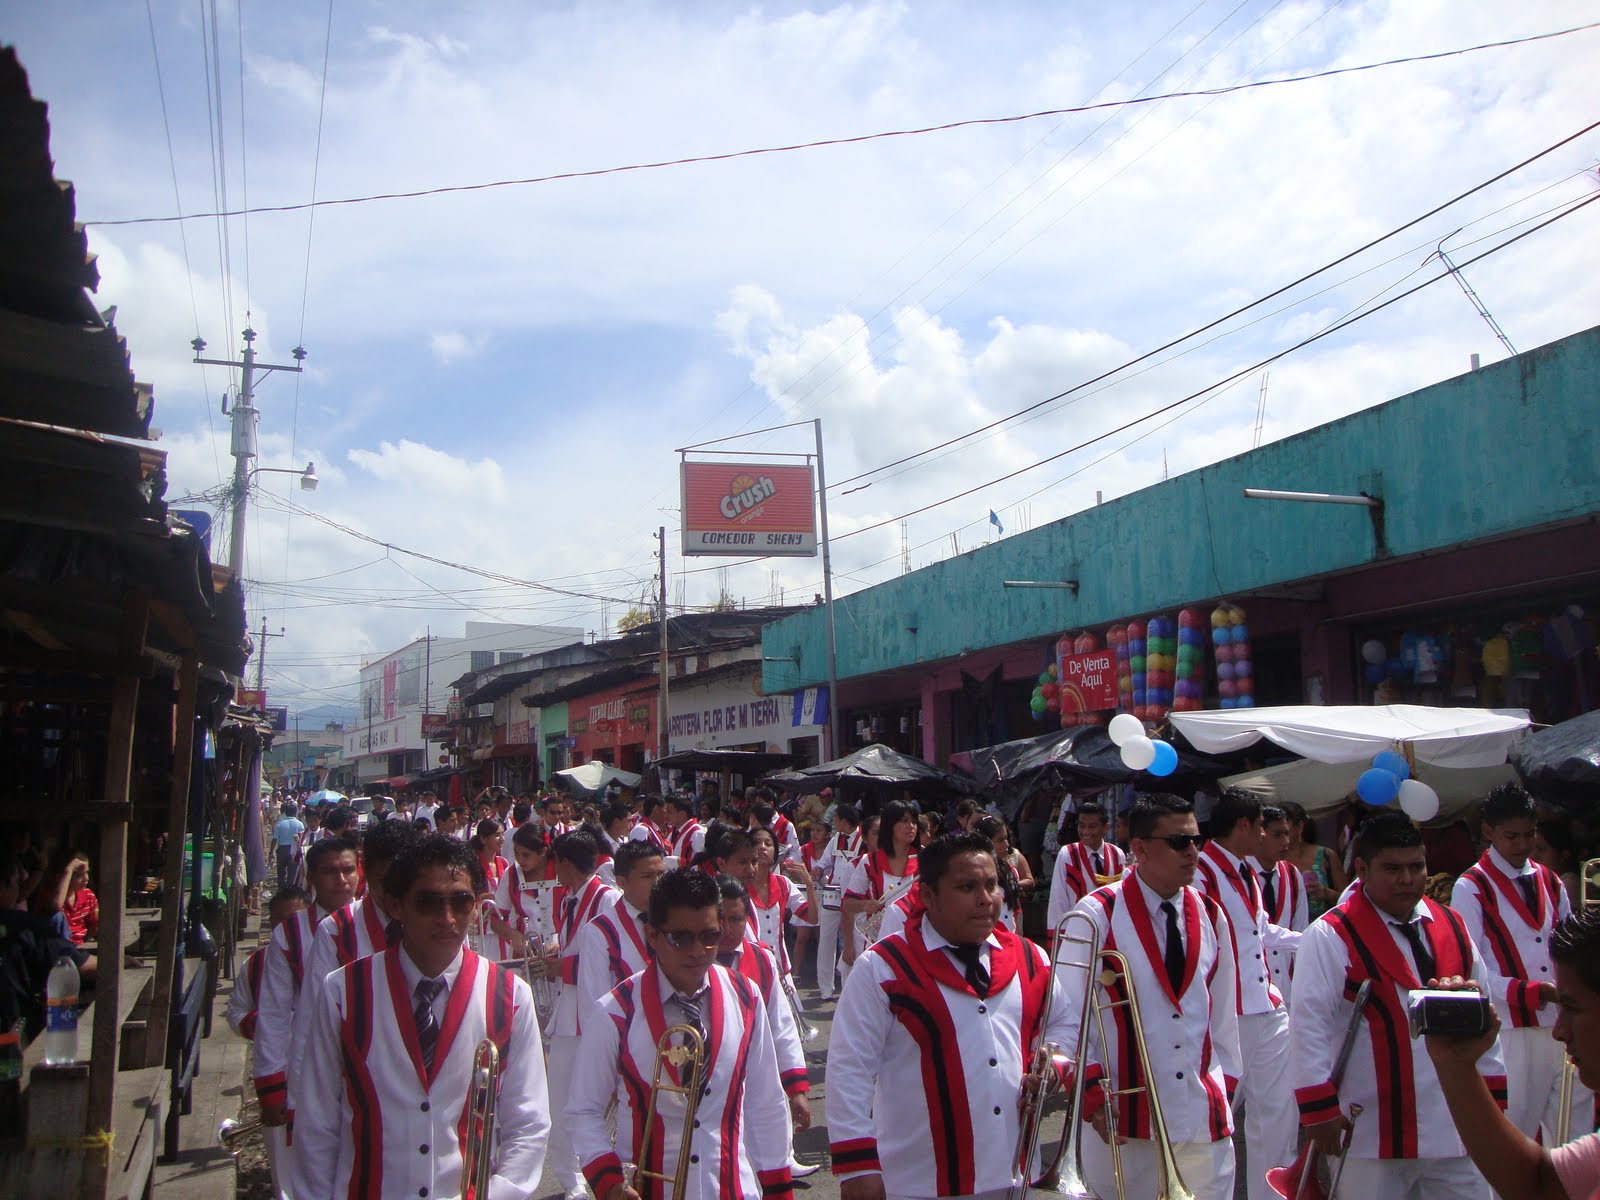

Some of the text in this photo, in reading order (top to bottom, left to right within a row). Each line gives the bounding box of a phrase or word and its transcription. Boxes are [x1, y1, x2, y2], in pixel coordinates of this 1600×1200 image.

[720, 476, 776, 520] Crush
[740, 507, 765, 525] orange
[702, 532, 803, 545] COMEDOR SHENY
[1069, 657, 1110, 675] De Venta
[1081, 670, 1103, 690] Aquí
[704, 708, 723, 733] FLOR
[726, 705, 736, 731] DE
[739, 704, 748, 729] MI
[751, 699, 780, 728] TIERRA
